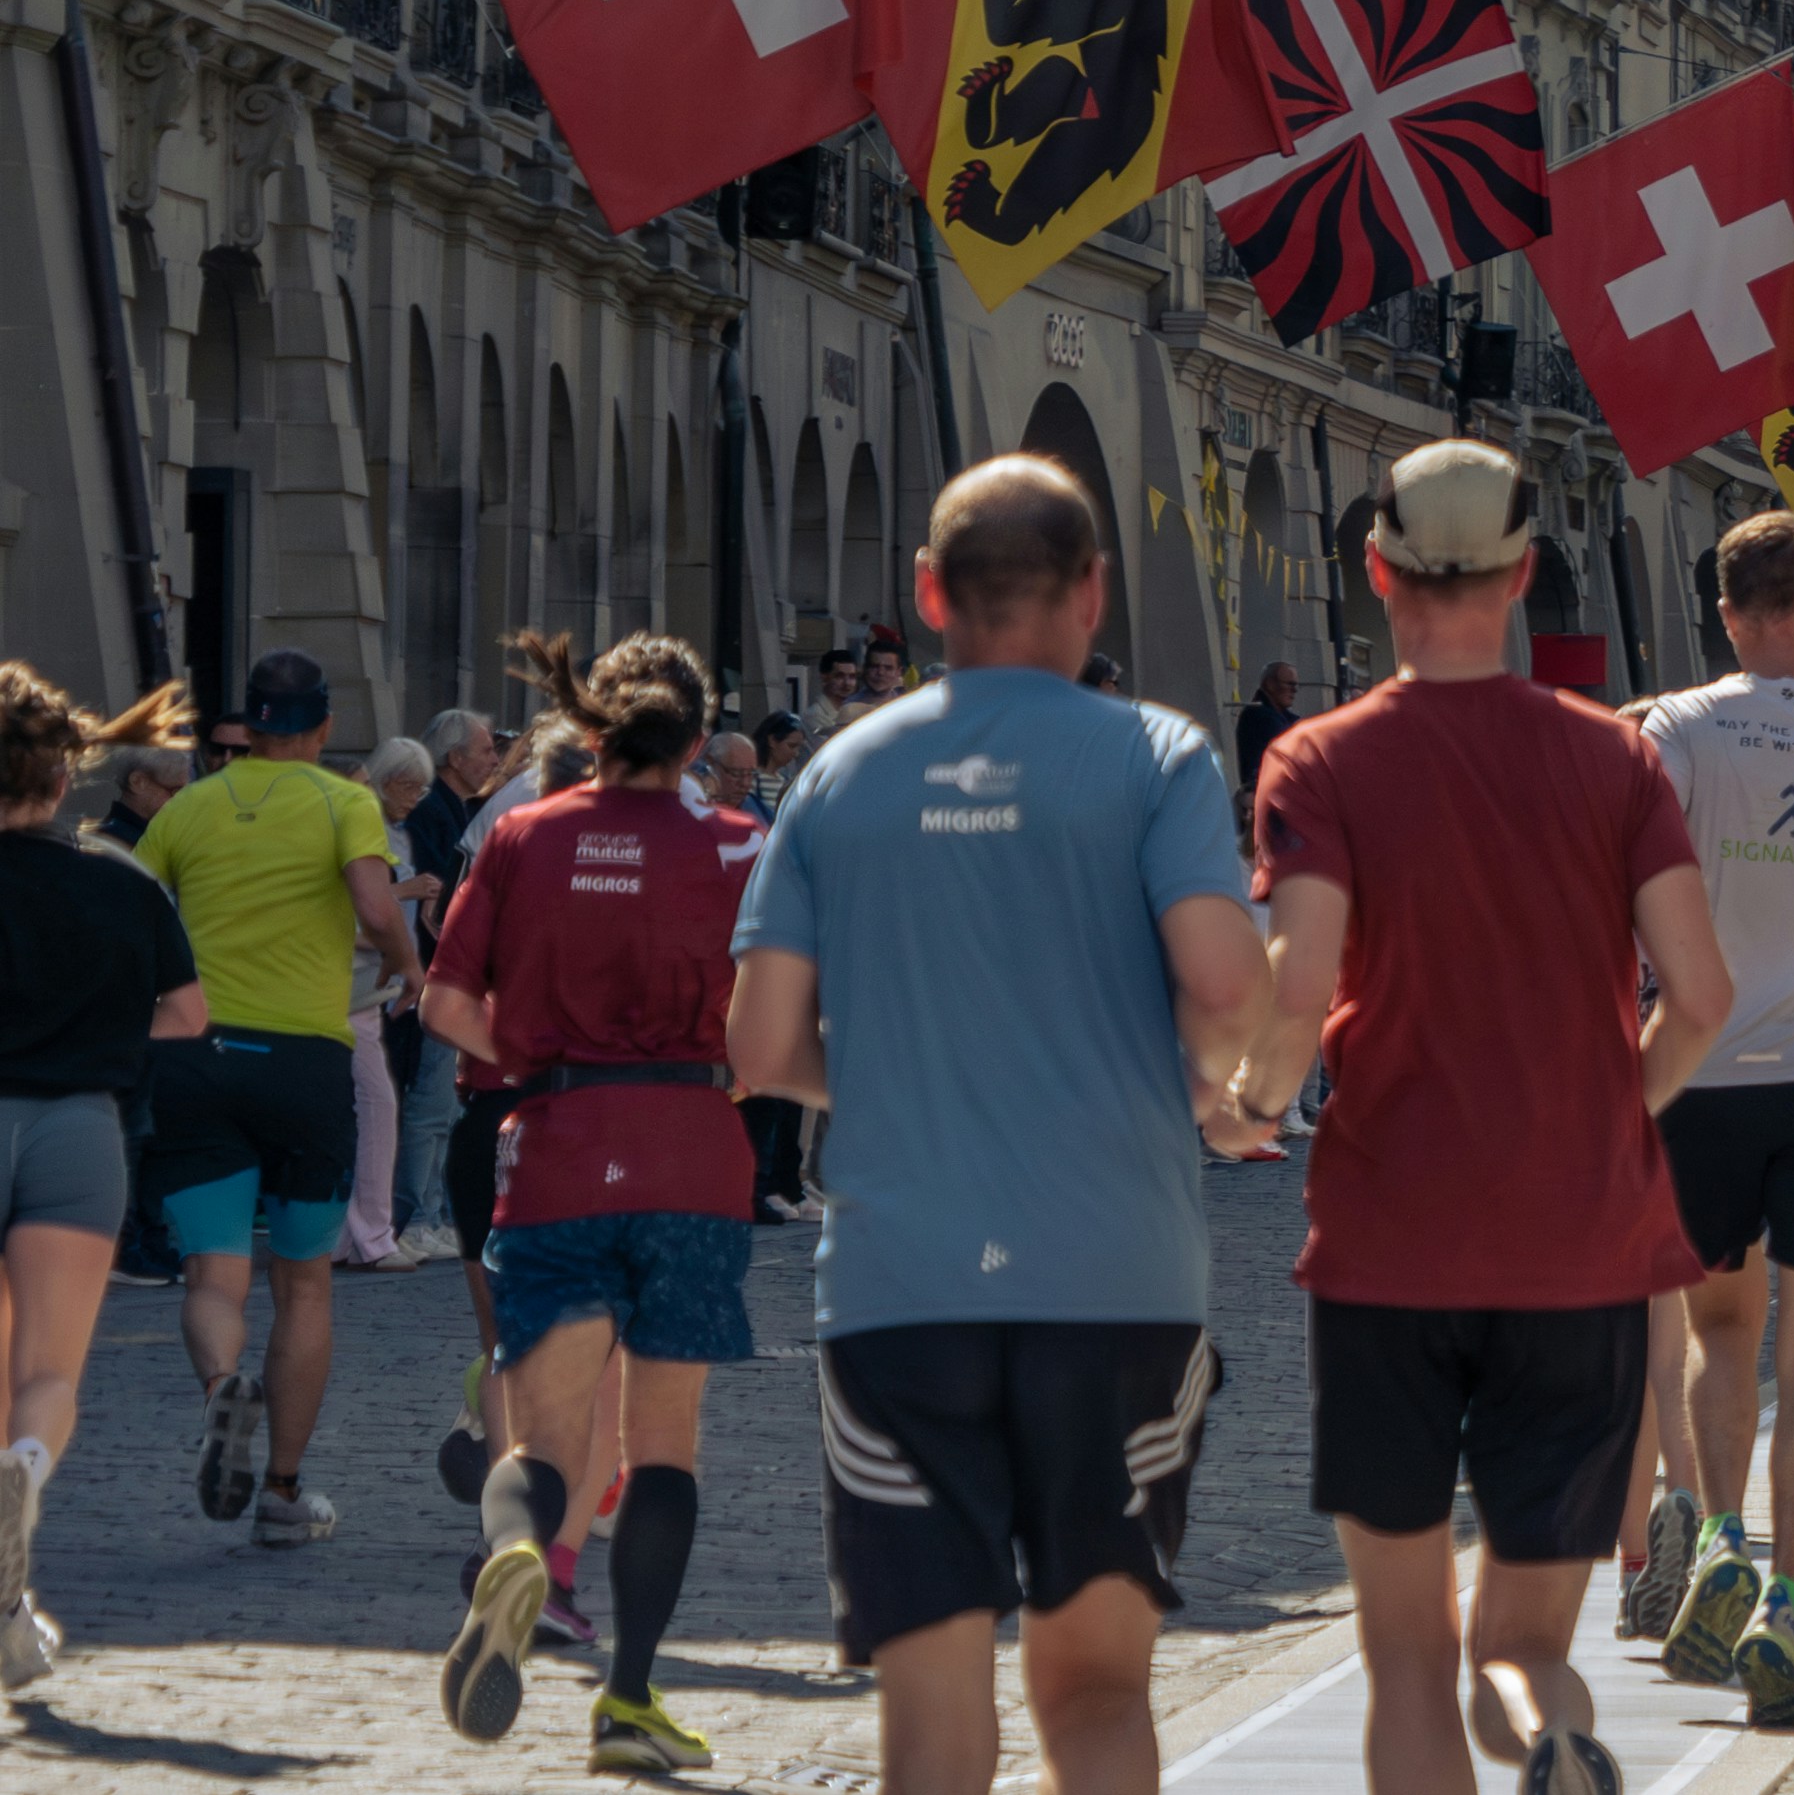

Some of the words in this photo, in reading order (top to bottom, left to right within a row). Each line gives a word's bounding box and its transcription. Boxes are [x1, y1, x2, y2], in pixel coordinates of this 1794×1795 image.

[1716, 719, 1749, 730] MAY
[1760, 721, 1791, 737] THE
[1739, 737, 1764, 748] BE
[919, 805, 1020, 833] MIGROS
[570, 875, 640, 895] MIGROS
